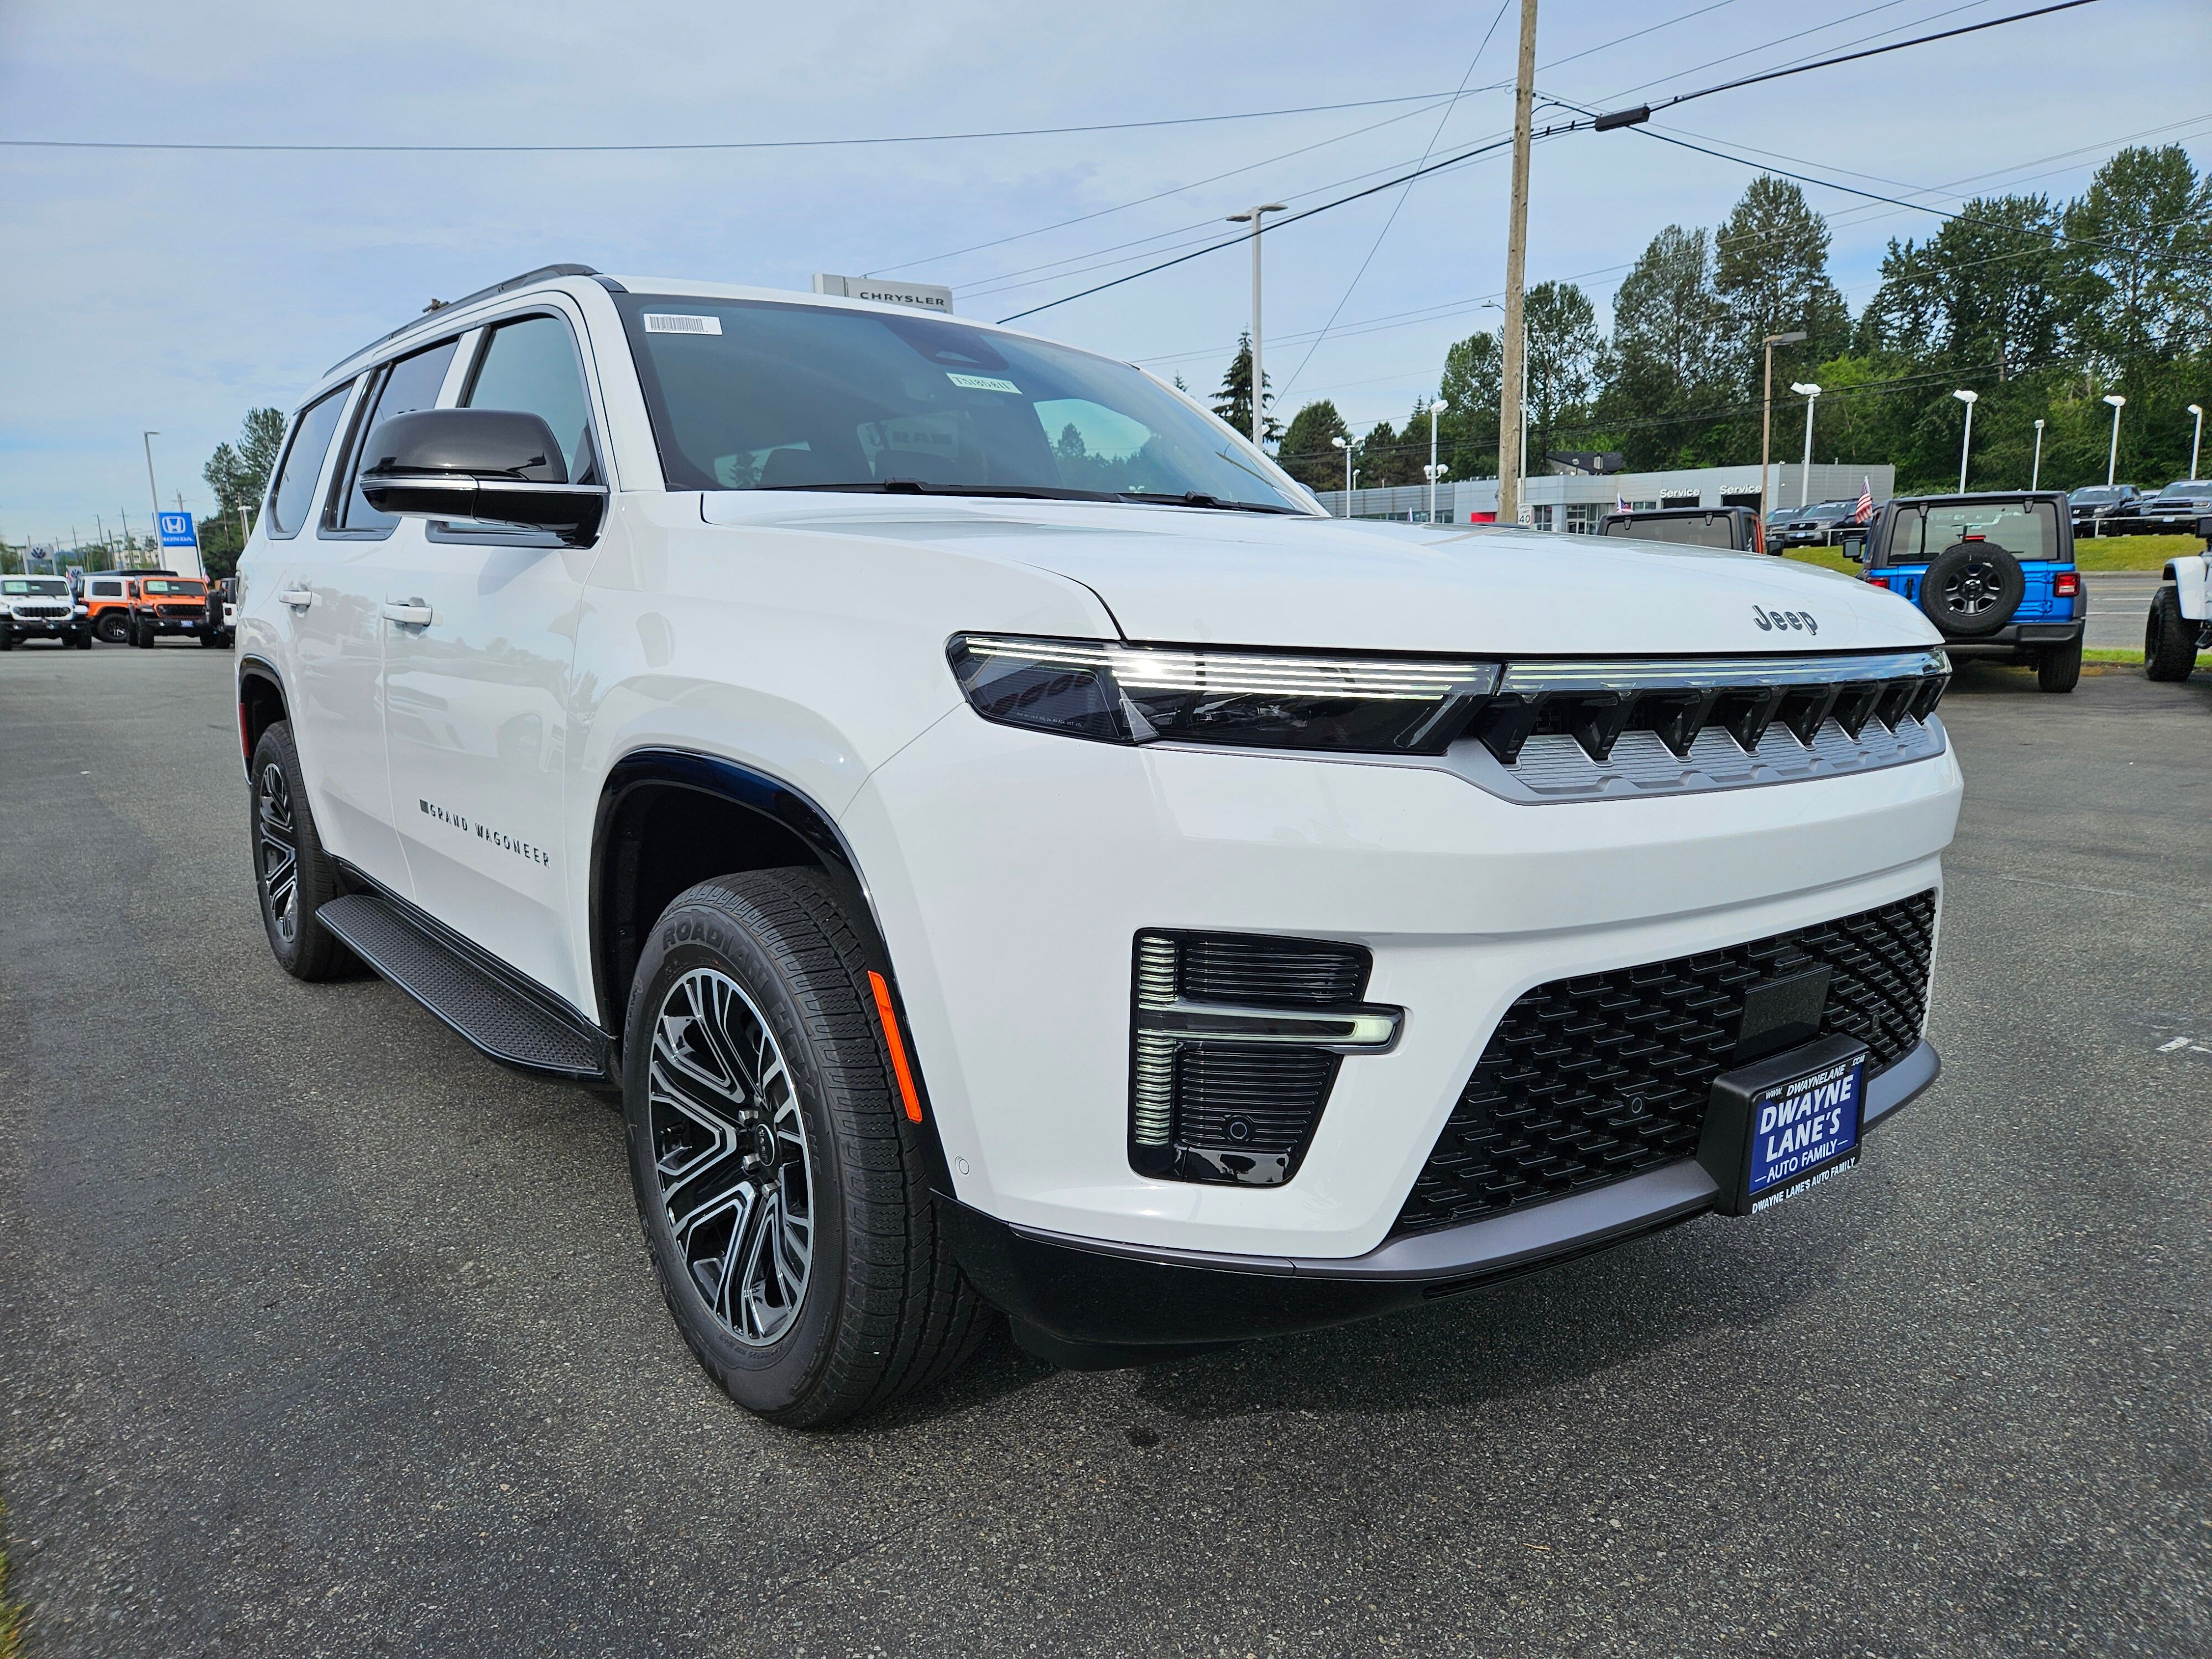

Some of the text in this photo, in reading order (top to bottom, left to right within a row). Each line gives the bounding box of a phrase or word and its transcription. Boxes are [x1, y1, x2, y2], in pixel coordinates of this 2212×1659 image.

[860, 291, 945, 306] CHRYSLER
[892, 431, 953, 445] RAM
[1660, 488, 1700, 498] Service
[1719, 484, 1763, 495] Service
[1519, 515, 1531, 523] 40
[1752, 605, 1818, 635] Jeep
[430, 804, 550, 869] GRAND WAGONEER
[1786, 1064, 1846, 1097] DWAYNELANE
[1760, 1074, 1854, 1135] DWAYNE
[1766, 1108, 1841, 1162] LANE'S
[1767, 1139, 1838, 1183] AUTO FAMILY
[1752, 1157, 1856, 1214] DWAYNE LANE'S AUTO FAMILY
